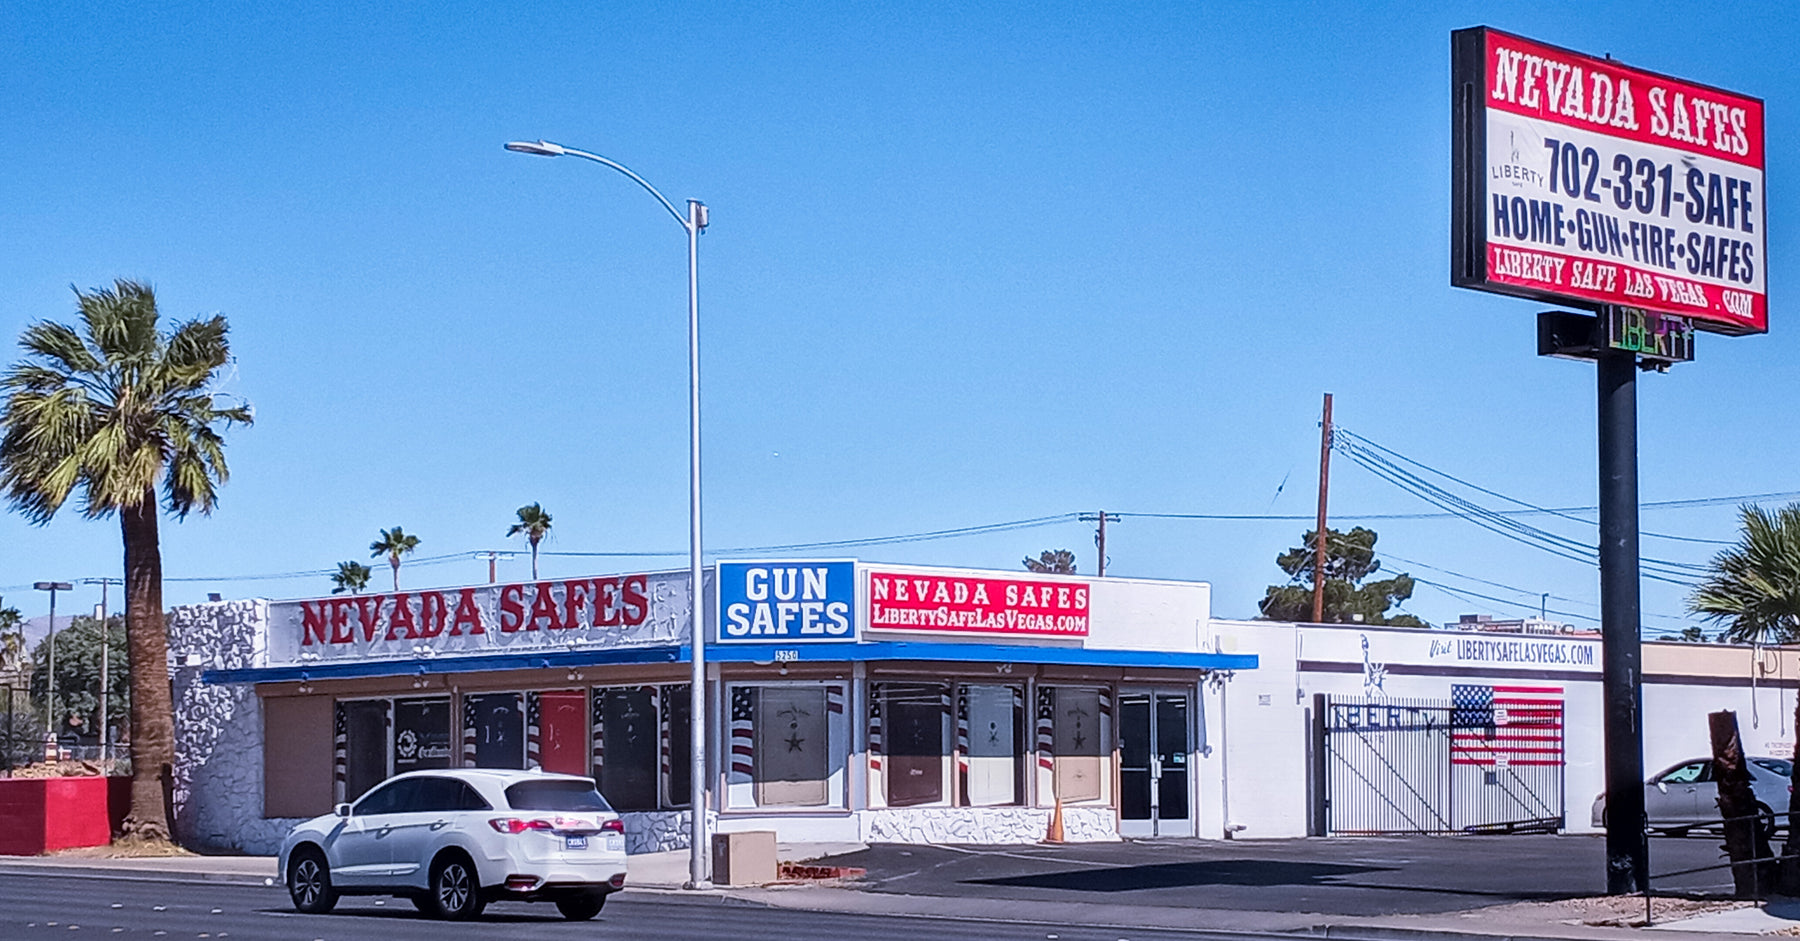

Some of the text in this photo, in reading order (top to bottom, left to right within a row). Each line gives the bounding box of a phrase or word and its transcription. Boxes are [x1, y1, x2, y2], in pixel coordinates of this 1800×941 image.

[1492, 47, 1749, 157] NEVADA SAFES
[1492, 164, 1544, 188] LIBERTY
[1544, 137, 1753, 234] 702-331-SAFE
[1493, 247, 1566, 285] LIBERTY
[1570, 260, 1616, 293] SAFE
[1624, 268, 1655, 300] LAS
[1654, 276, 1708, 309] VEGAS
[746, 567, 829, 601] GUN
[873, 578, 1087, 610] NEVADA SAFES
[301, 574, 649, 646] NEVADA SAFES
[727, 602, 849, 636] SAFES
[1429, 639, 1593, 665] Visit LIBERTYSAFELASVEGAS.COM
